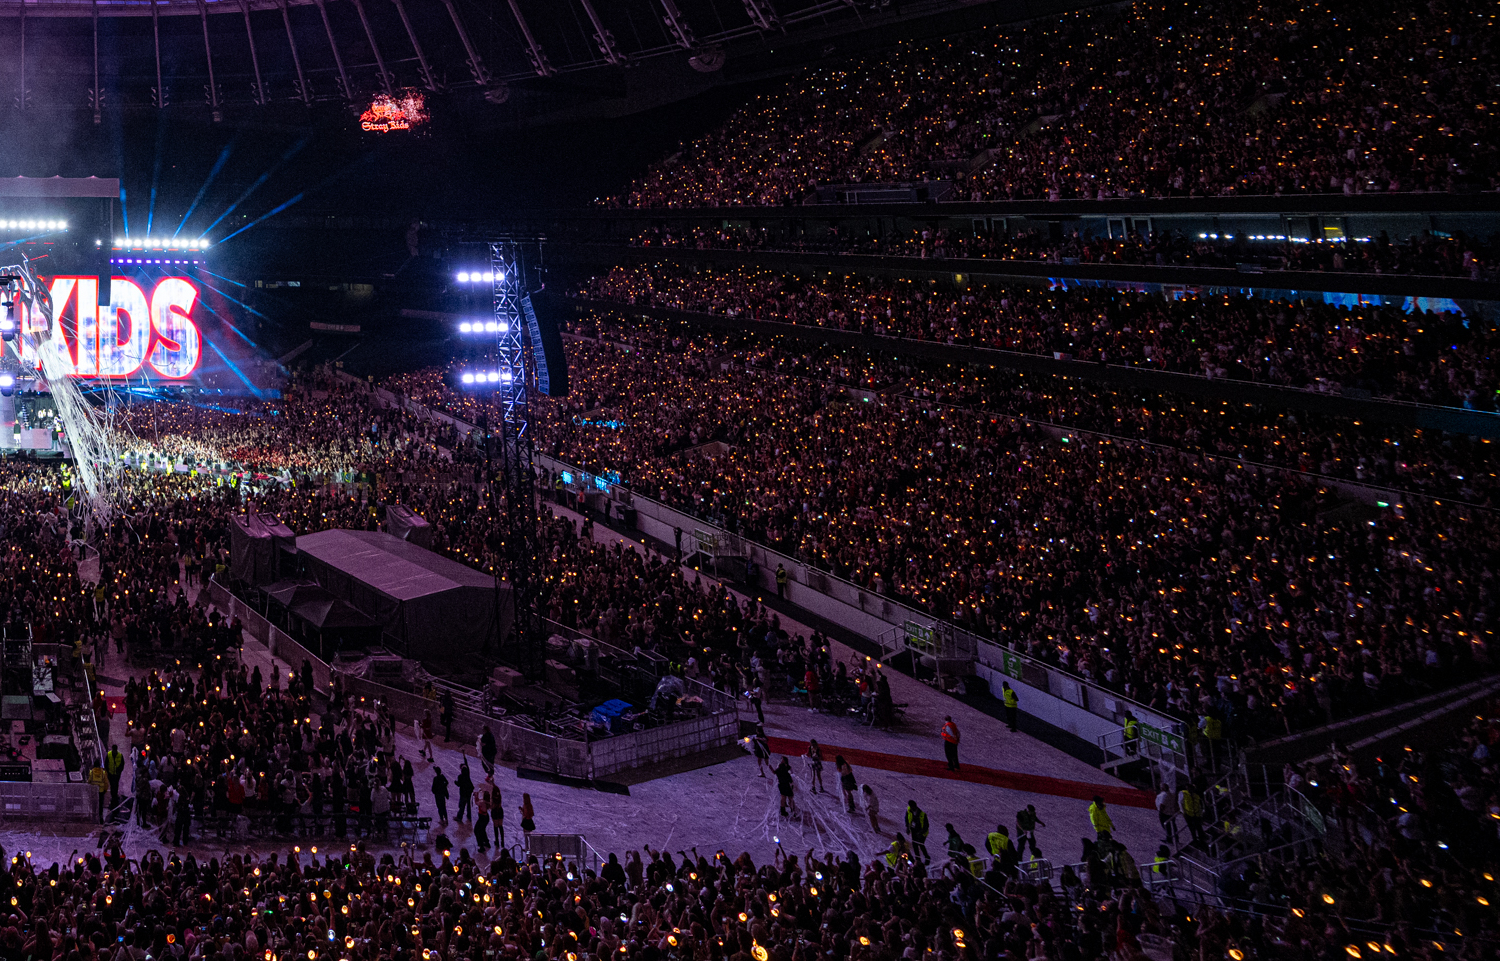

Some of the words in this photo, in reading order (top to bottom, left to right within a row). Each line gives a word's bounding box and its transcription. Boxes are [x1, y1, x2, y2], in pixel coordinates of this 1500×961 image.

[361, 121, 389, 133] Stray
[388, 120, 409, 130] Kids
[21, 275, 202, 379] KIDS
[1142, 726, 1160, 741] EXIT
